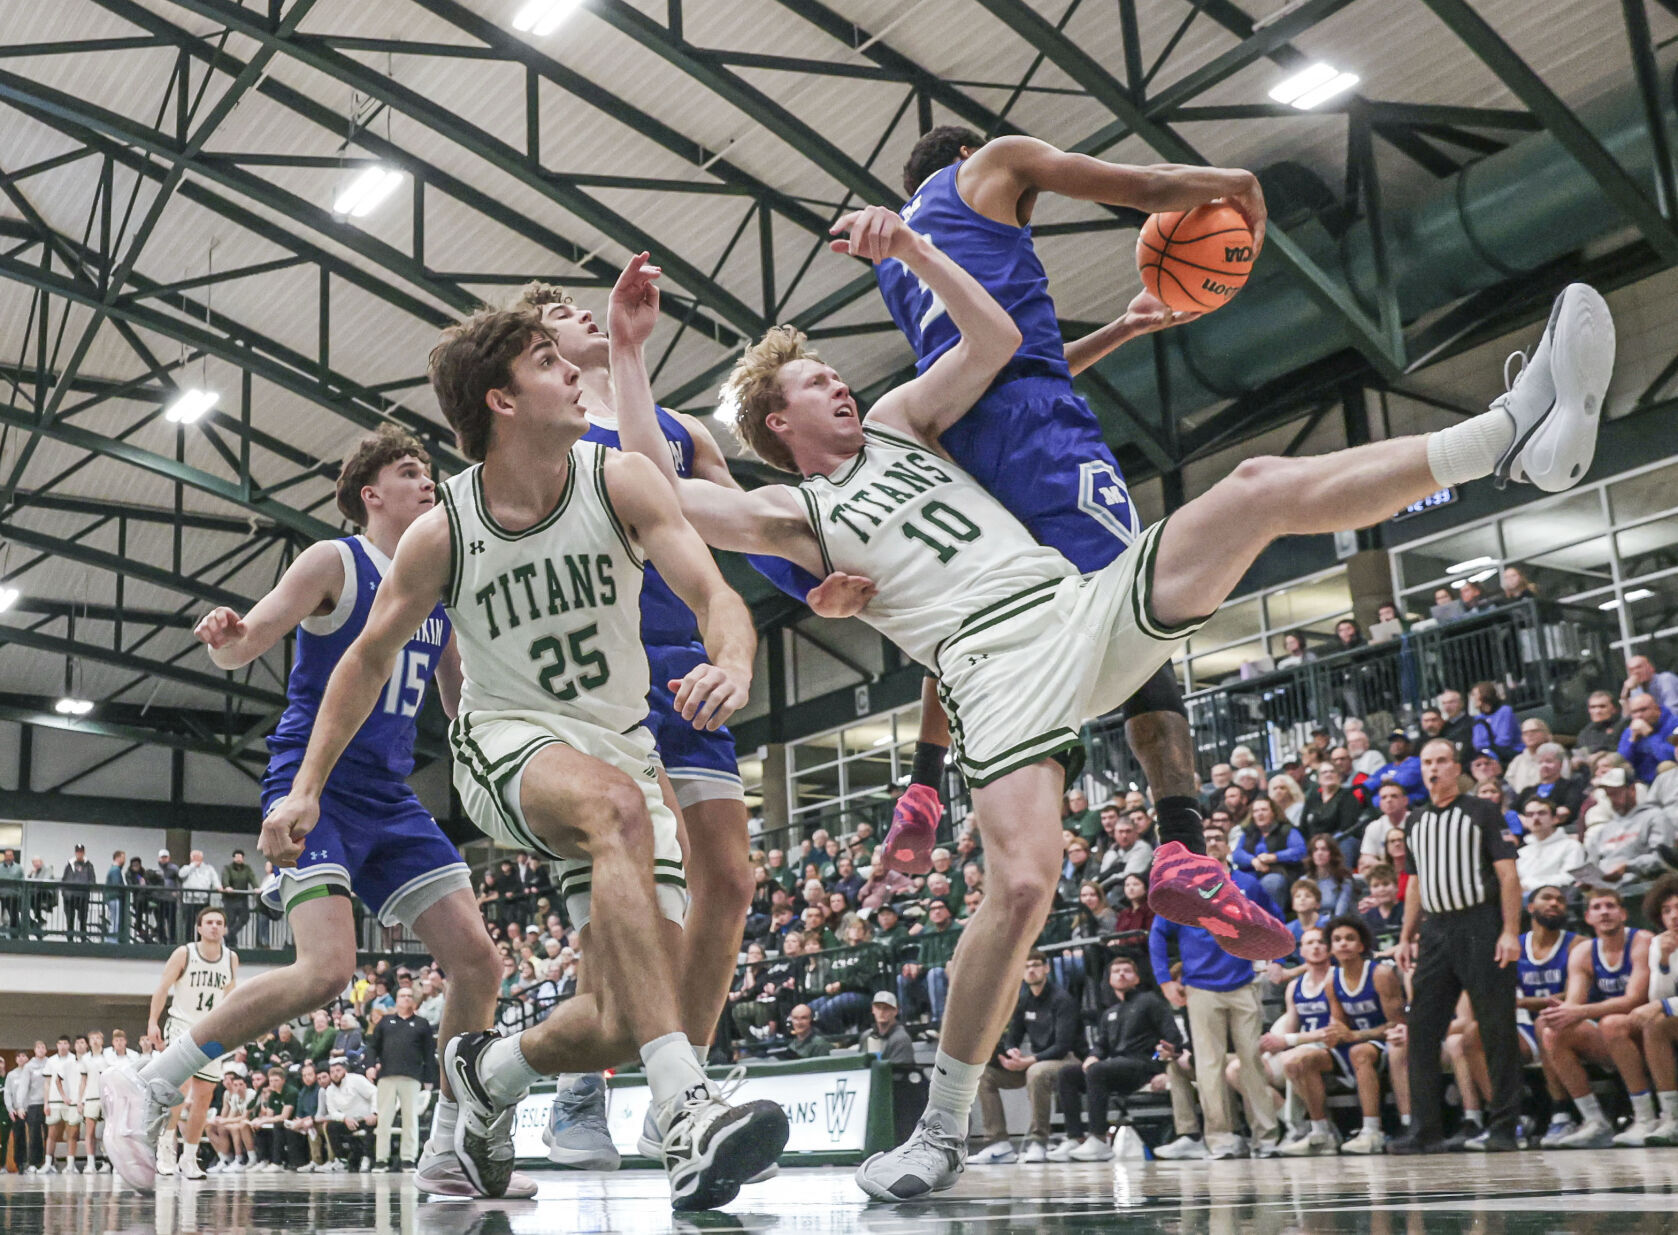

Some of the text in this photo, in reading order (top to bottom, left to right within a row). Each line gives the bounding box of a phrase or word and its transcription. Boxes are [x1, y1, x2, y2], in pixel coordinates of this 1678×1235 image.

[1224, 246, 1252, 263] CAA
[830, 452, 953, 544] TITANS
[902, 500, 982, 565] 10
[476, 553, 617, 640] TITANS
[383, 649, 430, 718] 15
[529, 623, 610, 701] 25
[190, 971, 227, 990] TITANS
[196, 992, 214, 1012] 14
[780, 1102, 817, 1124] ANS
